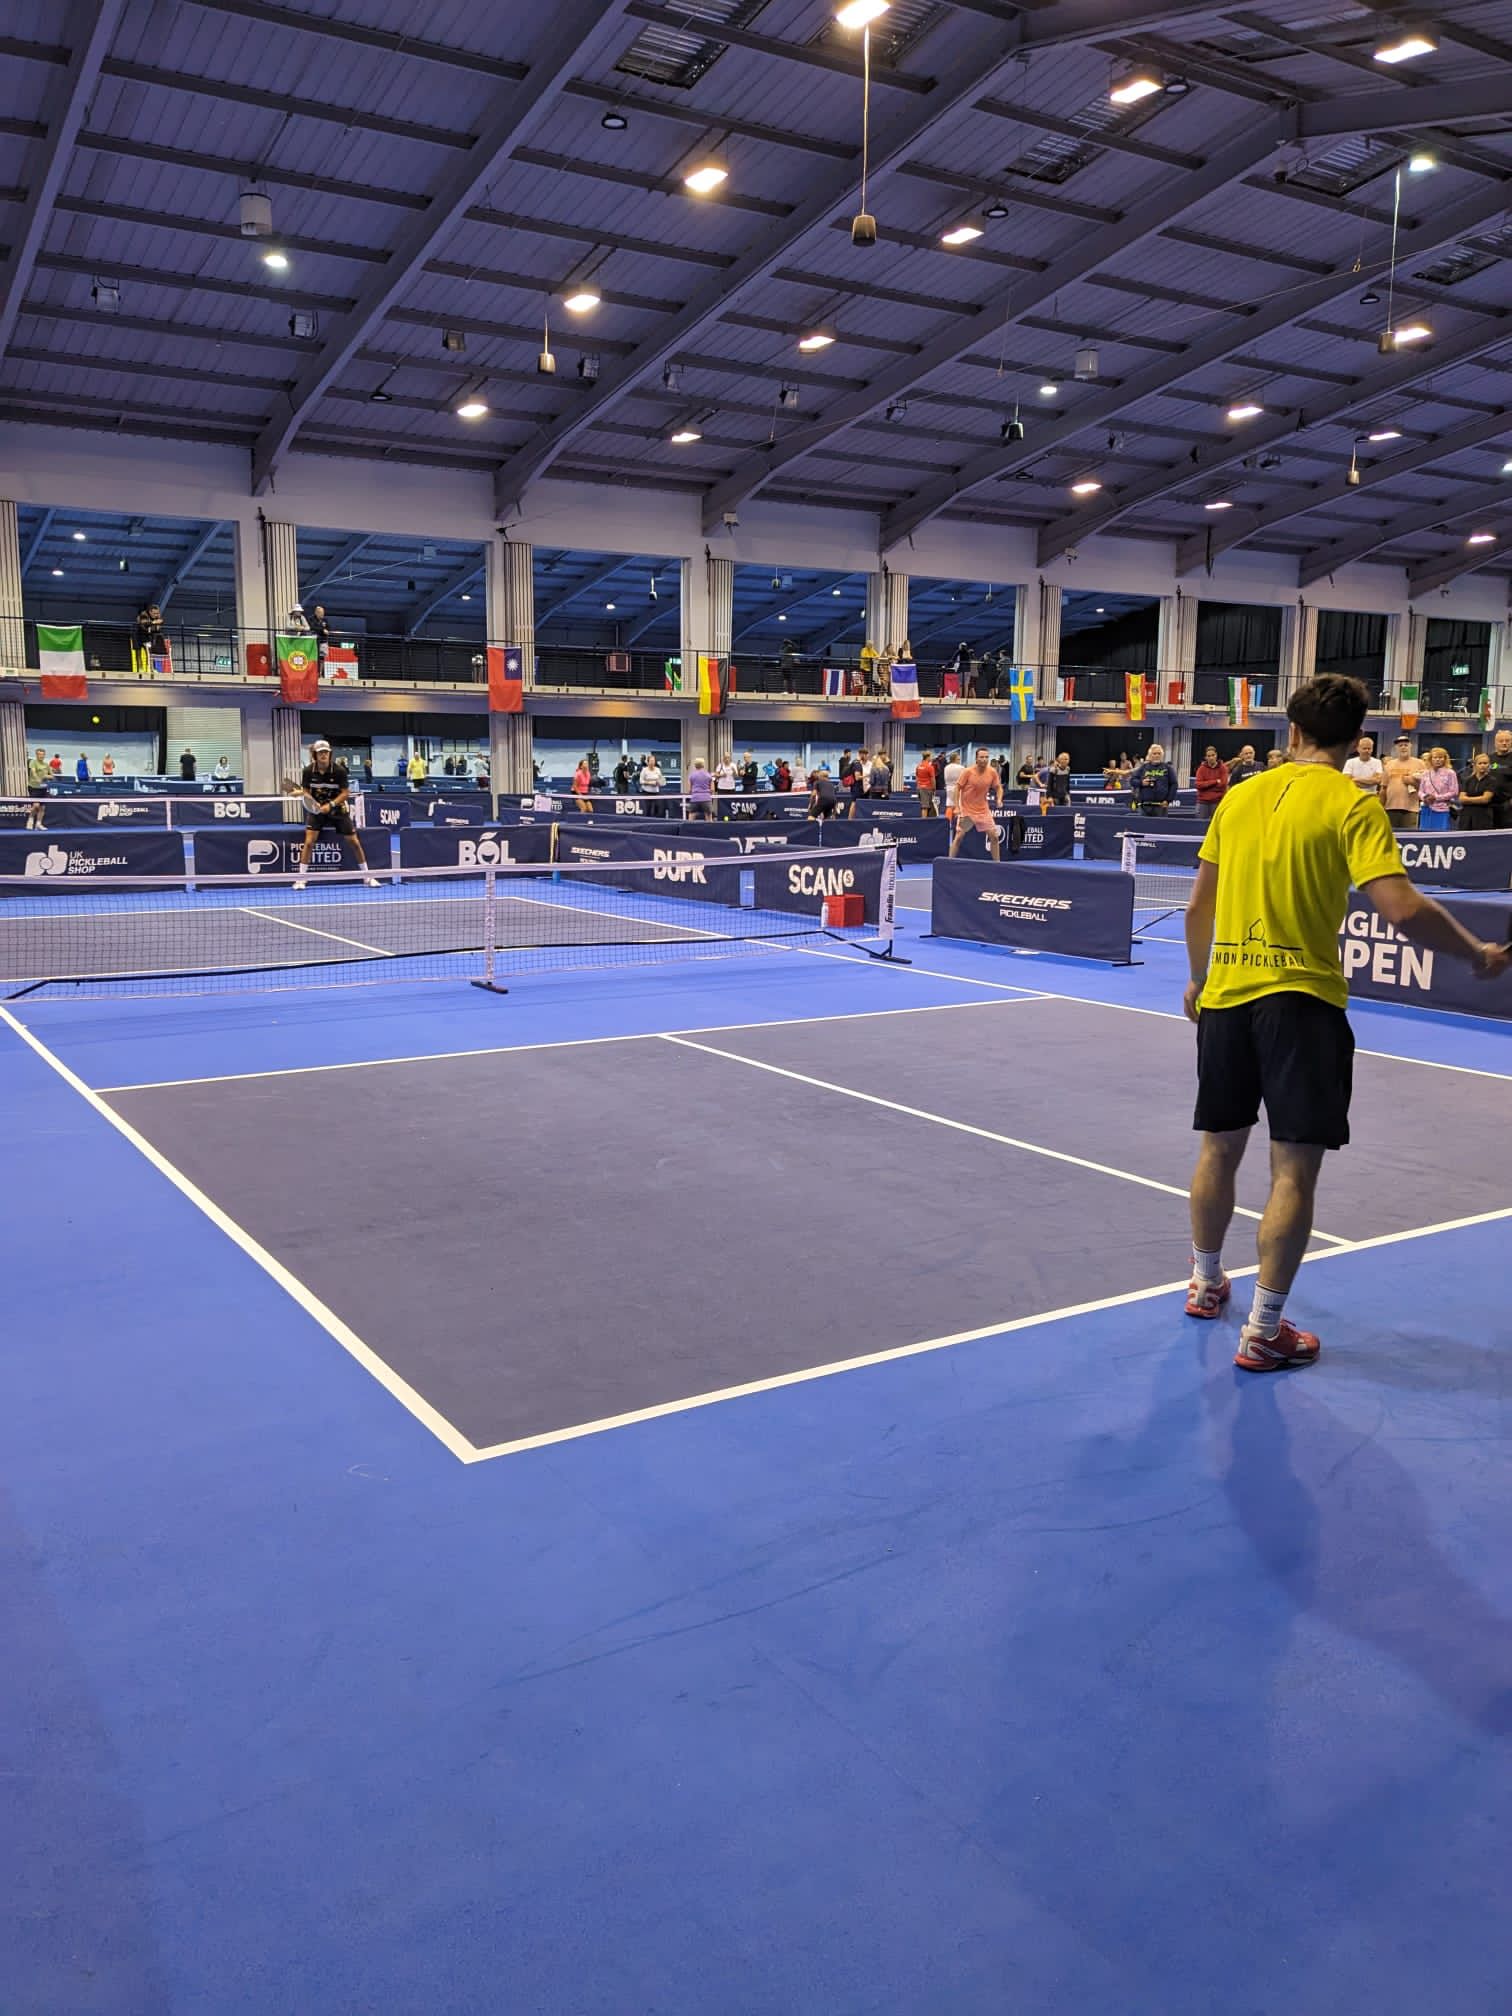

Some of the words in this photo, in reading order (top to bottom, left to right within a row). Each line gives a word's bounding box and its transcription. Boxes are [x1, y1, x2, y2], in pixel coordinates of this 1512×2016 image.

[69, 851, 83, 859] UK
[290, 851, 342, 863] UITED
[69, 857, 128, 867] PICKLEBALL
[68, 866, 96, 875] SHOP
[978, 891, 1073, 910] SKECHERS
[1000, 909, 1048, 922] PICKLEBALL
[1338, 939, 1434, 990] PEN
